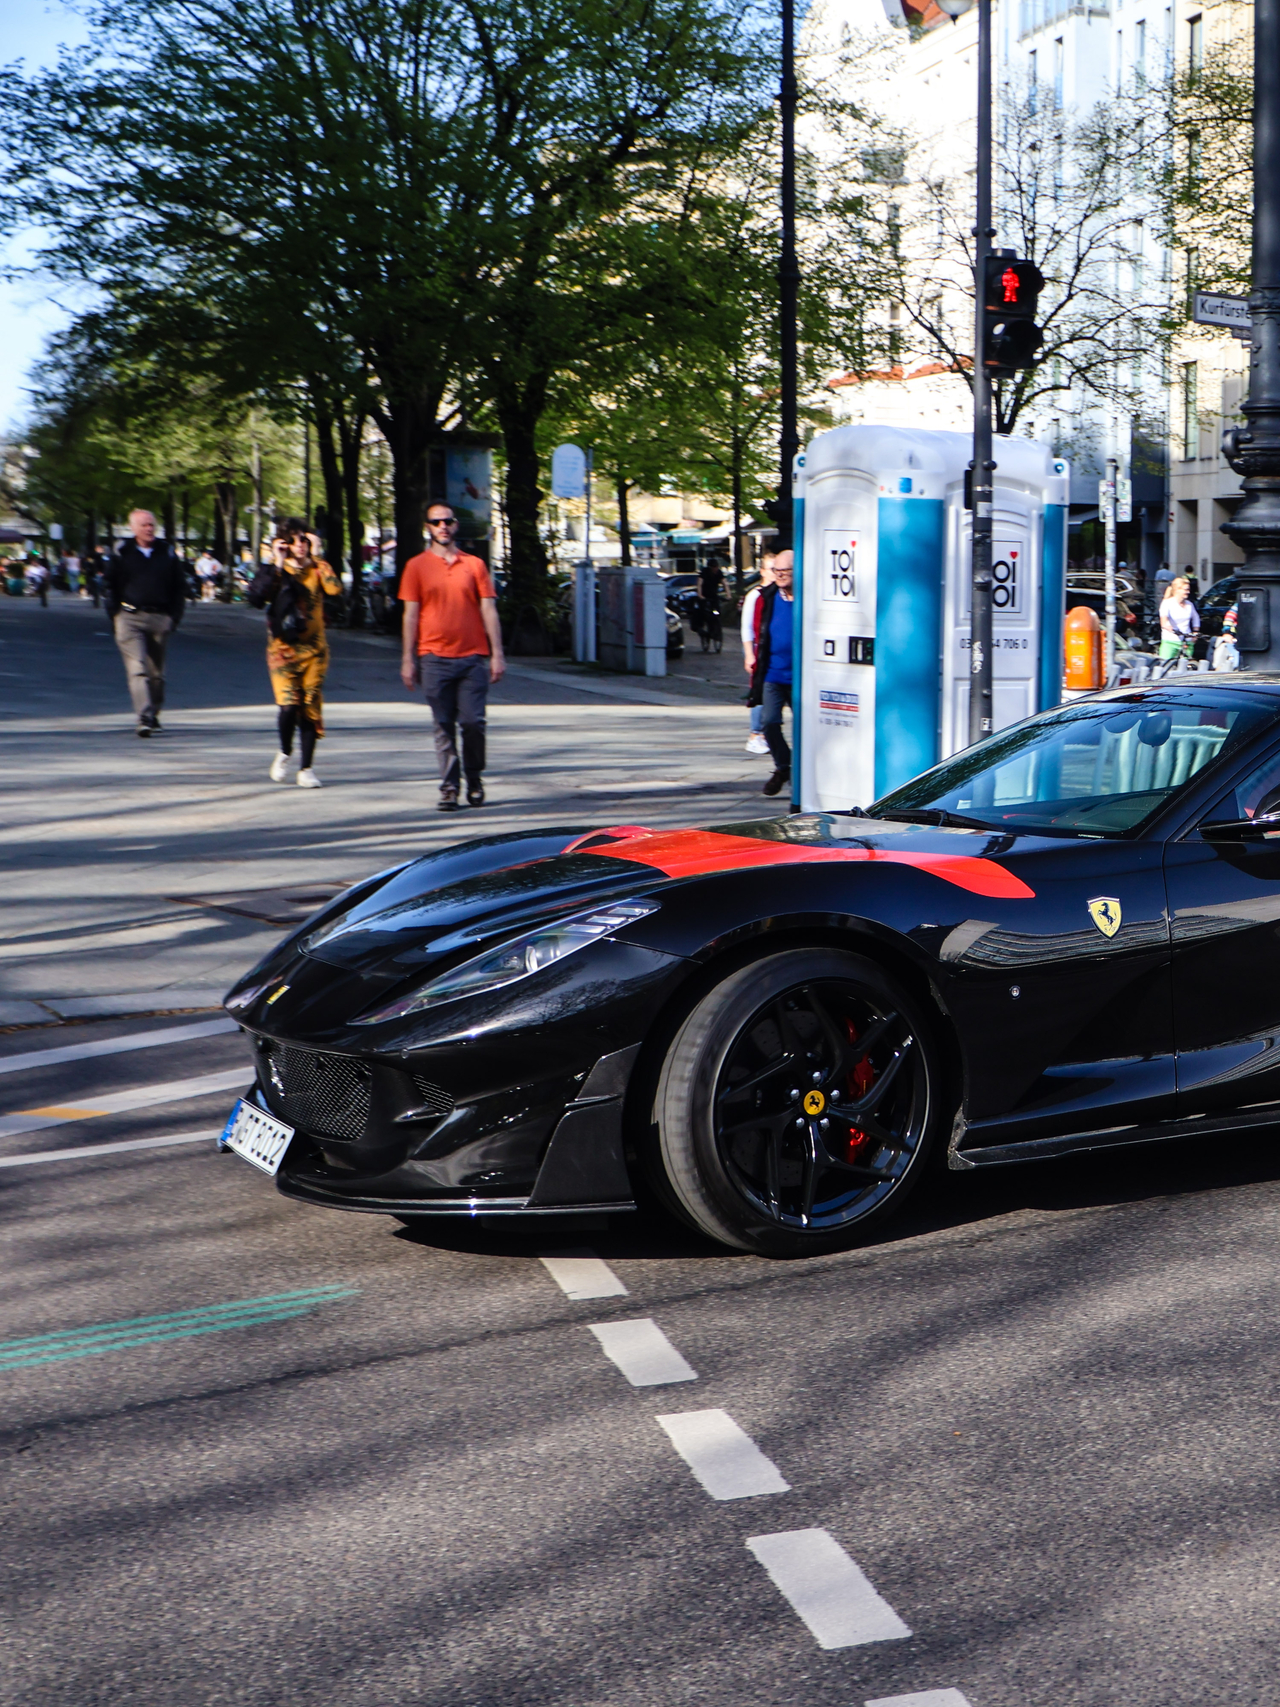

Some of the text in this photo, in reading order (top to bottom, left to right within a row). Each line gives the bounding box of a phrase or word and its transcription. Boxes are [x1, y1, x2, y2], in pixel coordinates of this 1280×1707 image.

[1199, 298, 1251, 319] Kurfürste
[831, 549, 855, 573] TOI
[992, 560, 1016, 583] OI
[831, 574, 855, 597] TOI
[992, 584, 1015, 607] OI
